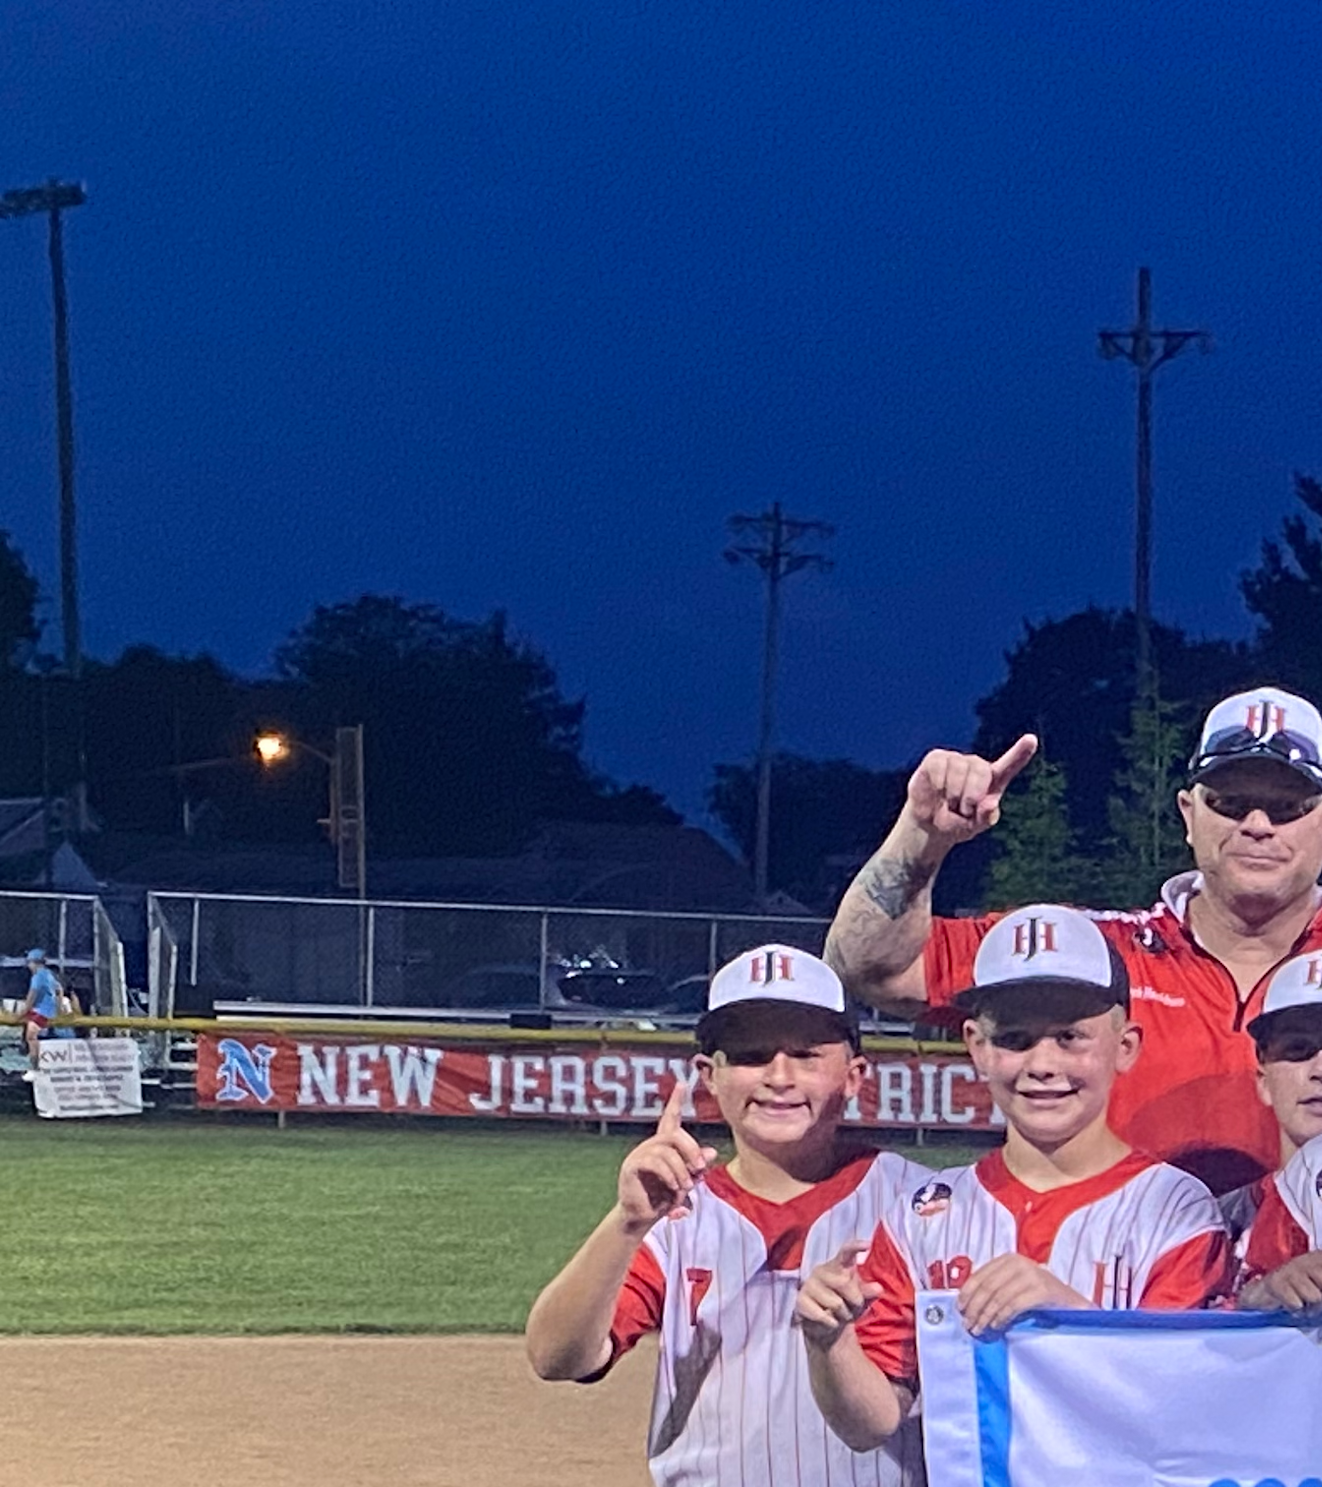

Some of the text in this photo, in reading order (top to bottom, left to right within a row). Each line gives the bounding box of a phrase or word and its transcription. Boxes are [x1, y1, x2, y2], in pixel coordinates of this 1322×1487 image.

[215, 1038, 276, 1105] N
[297, 1043, 443, 1107] NEW
[469, 1055, 698, 1117] JERSEY
[685, 1267, 714, 1328] 7
